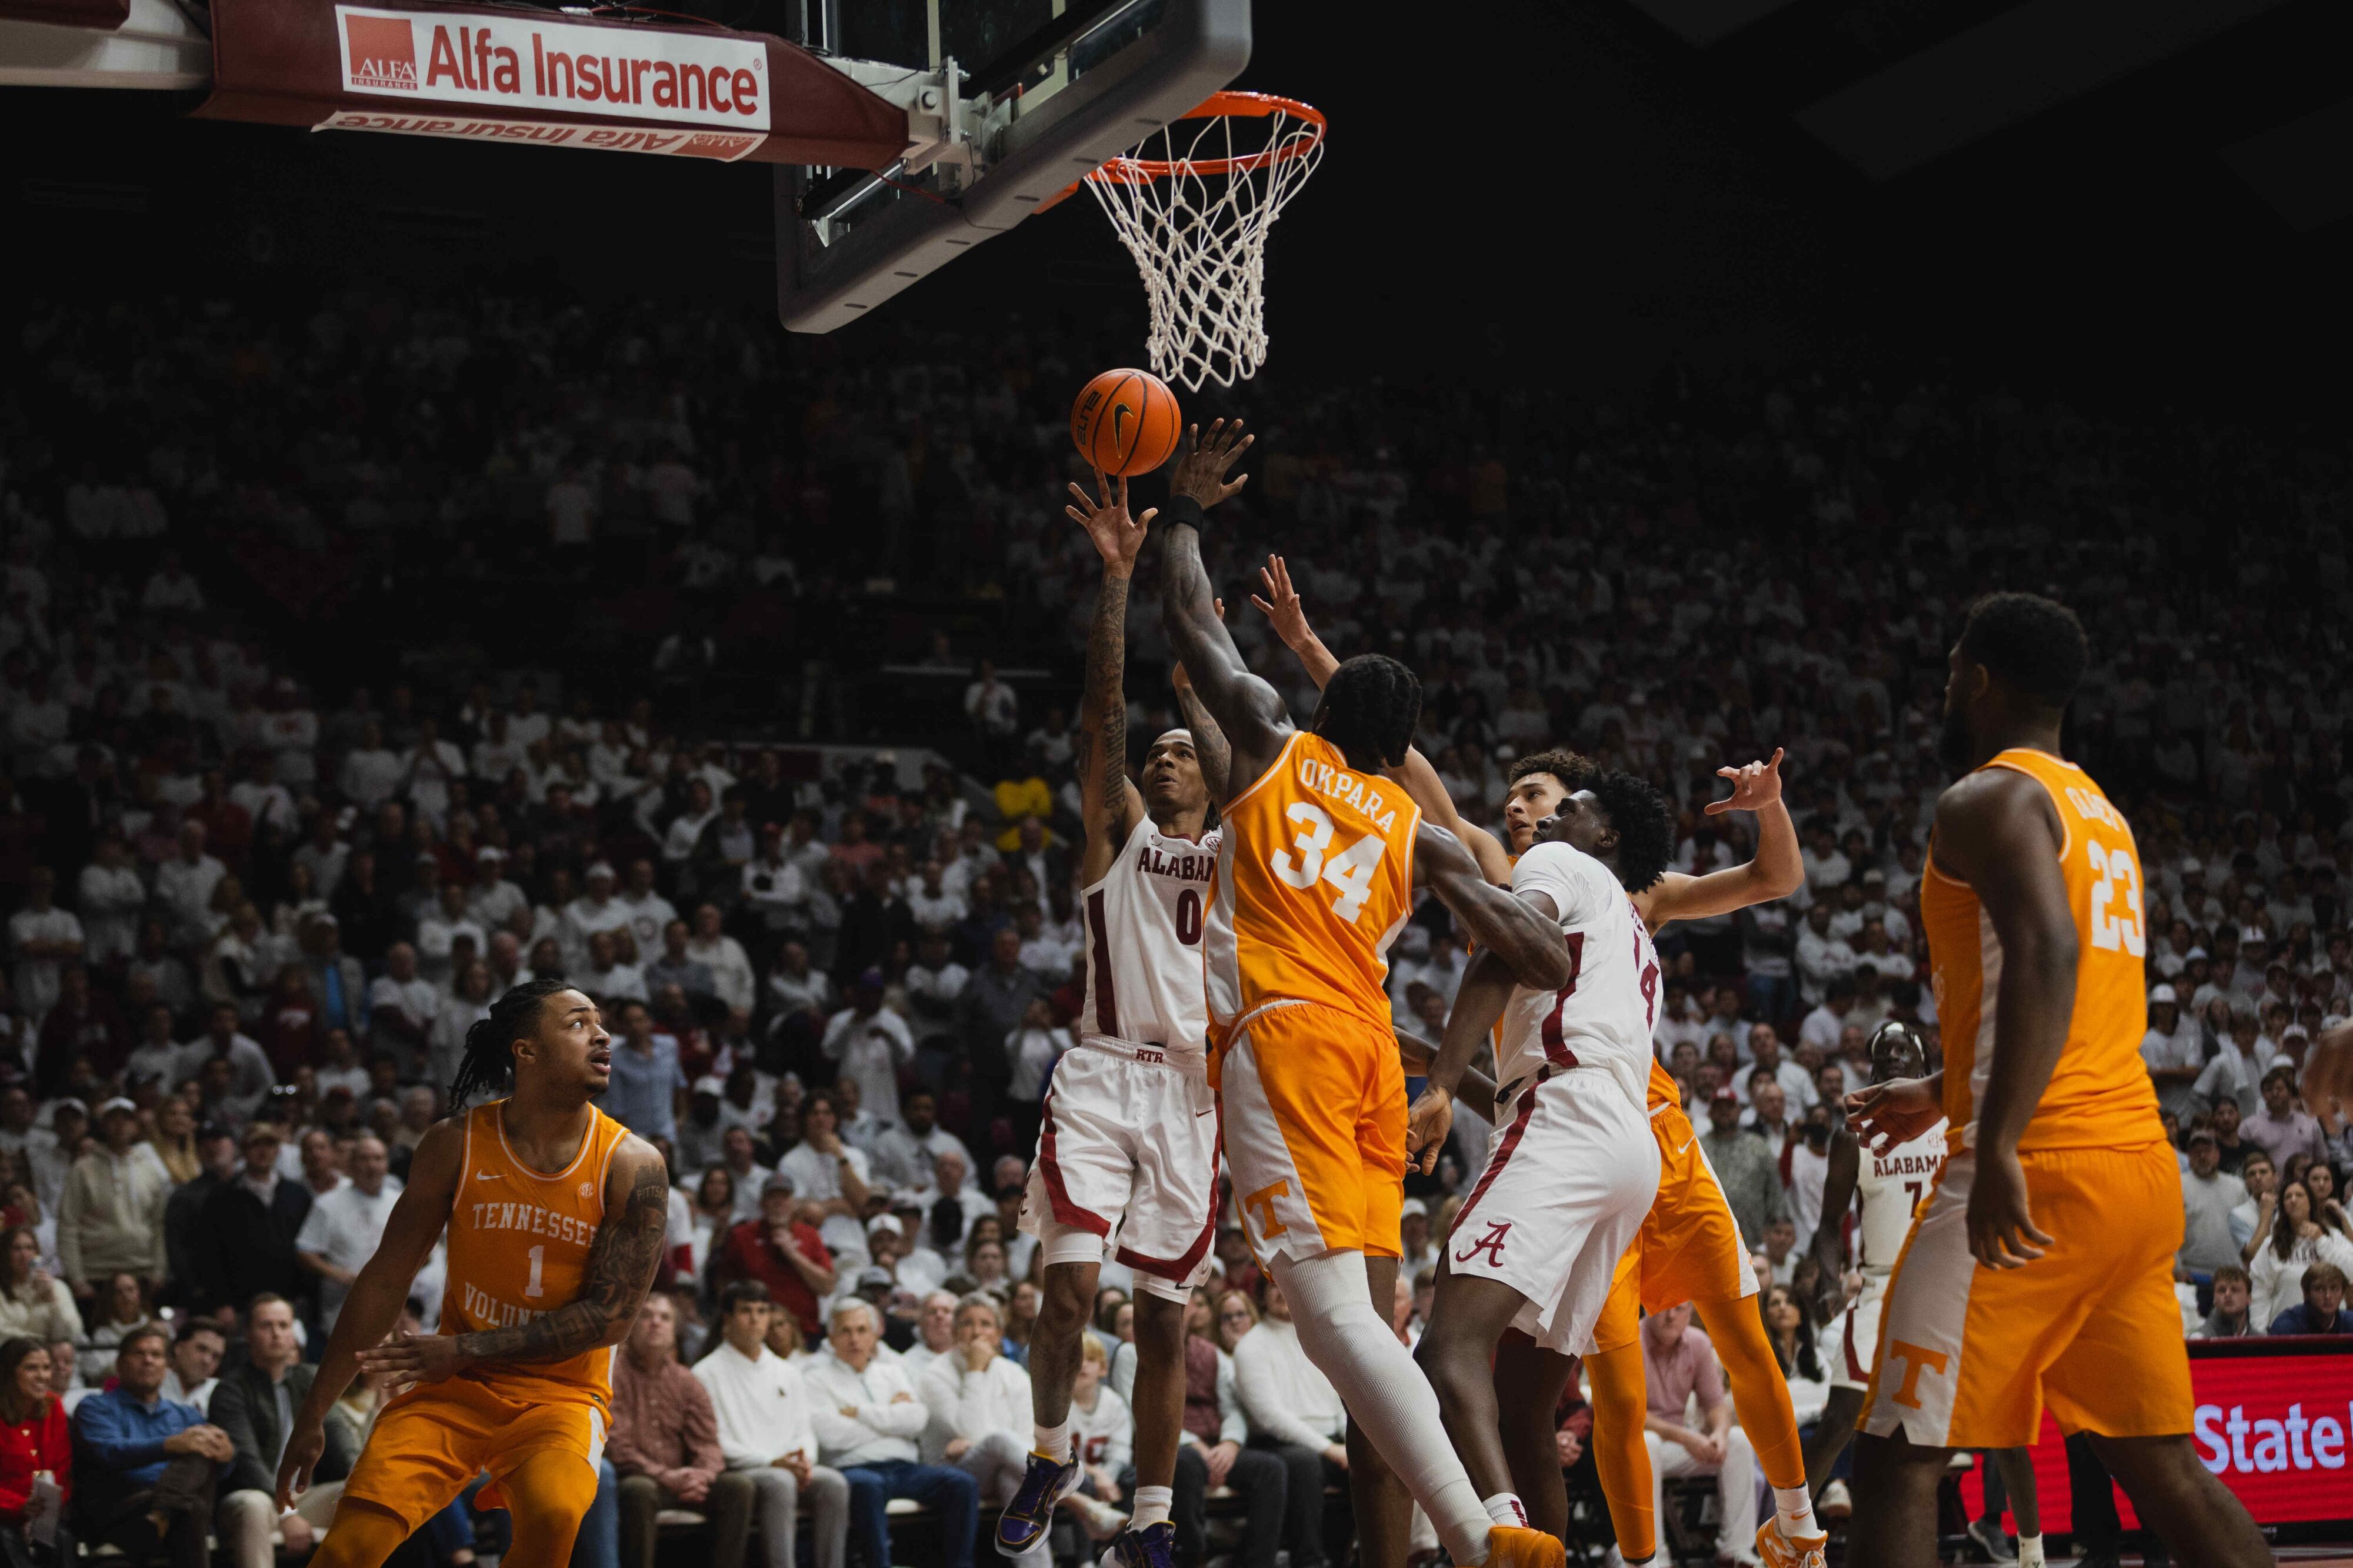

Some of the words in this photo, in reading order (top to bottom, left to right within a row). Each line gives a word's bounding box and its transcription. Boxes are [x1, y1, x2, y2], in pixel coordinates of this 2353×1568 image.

[354, 78, 415, 90] INSURANCE
[359, 57, 416, 81] ALFA
[426, 25, 520, 94] Alfa
[336, 116, 577, 144] Insurance
[582, 130, 684, 151] Alfa
[1077, 389, 1102, 446] ELITE
[1301, 759, 1396, 833] OKPARA
[1271, 802, 1387, 925] 34
[1176, 889, 1201, 946] 0
[2087, 840, 2146, 958] 23
[1136, 1048, 1164, 1064] RTR
[1905, 1182, 1922, 1219] 7
[525, 1245, 544, 1297] 1
[2194, 1402, 2345, 1474] State
